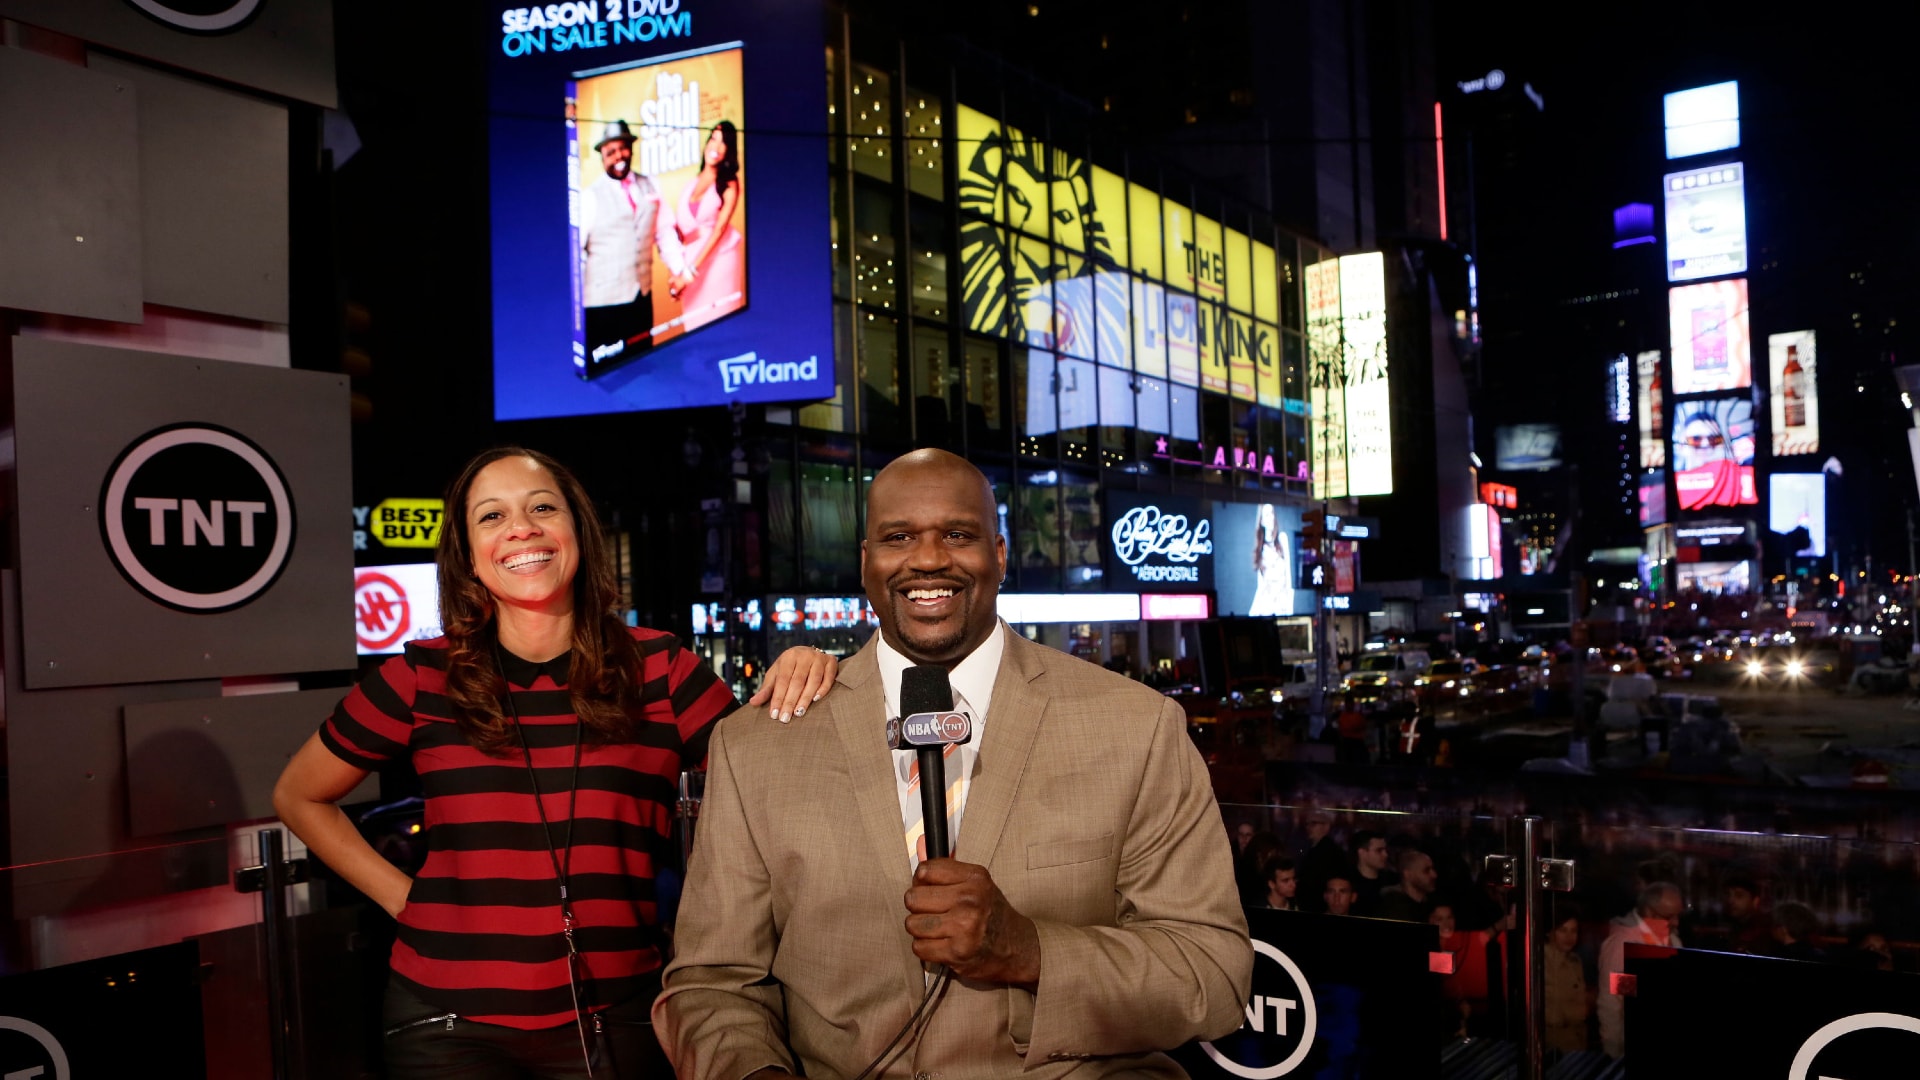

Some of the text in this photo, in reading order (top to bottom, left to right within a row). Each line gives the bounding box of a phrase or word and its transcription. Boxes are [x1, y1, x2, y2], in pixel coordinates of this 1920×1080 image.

[502, 0, 680, 34] SEASON 2 DVD
[502, 11, 692, 57] ON SALE NOW!
[655, 71, 683, 99] the
[640, 80, 699, 137] soul
[640, 129, 699, 176] man
[1183, 241, 1225, 286] THE
[1211, 296, 1272, 369] KING
[135, 497, 267, 547] TNT
[381, 509, 442, 524] BEST
[384, 525, 435, 540] BUY
[908, 722, 931, 737] NBA
[946, 721, 964, 732] TNT
[1240, 995, 1297, 1036] NT
